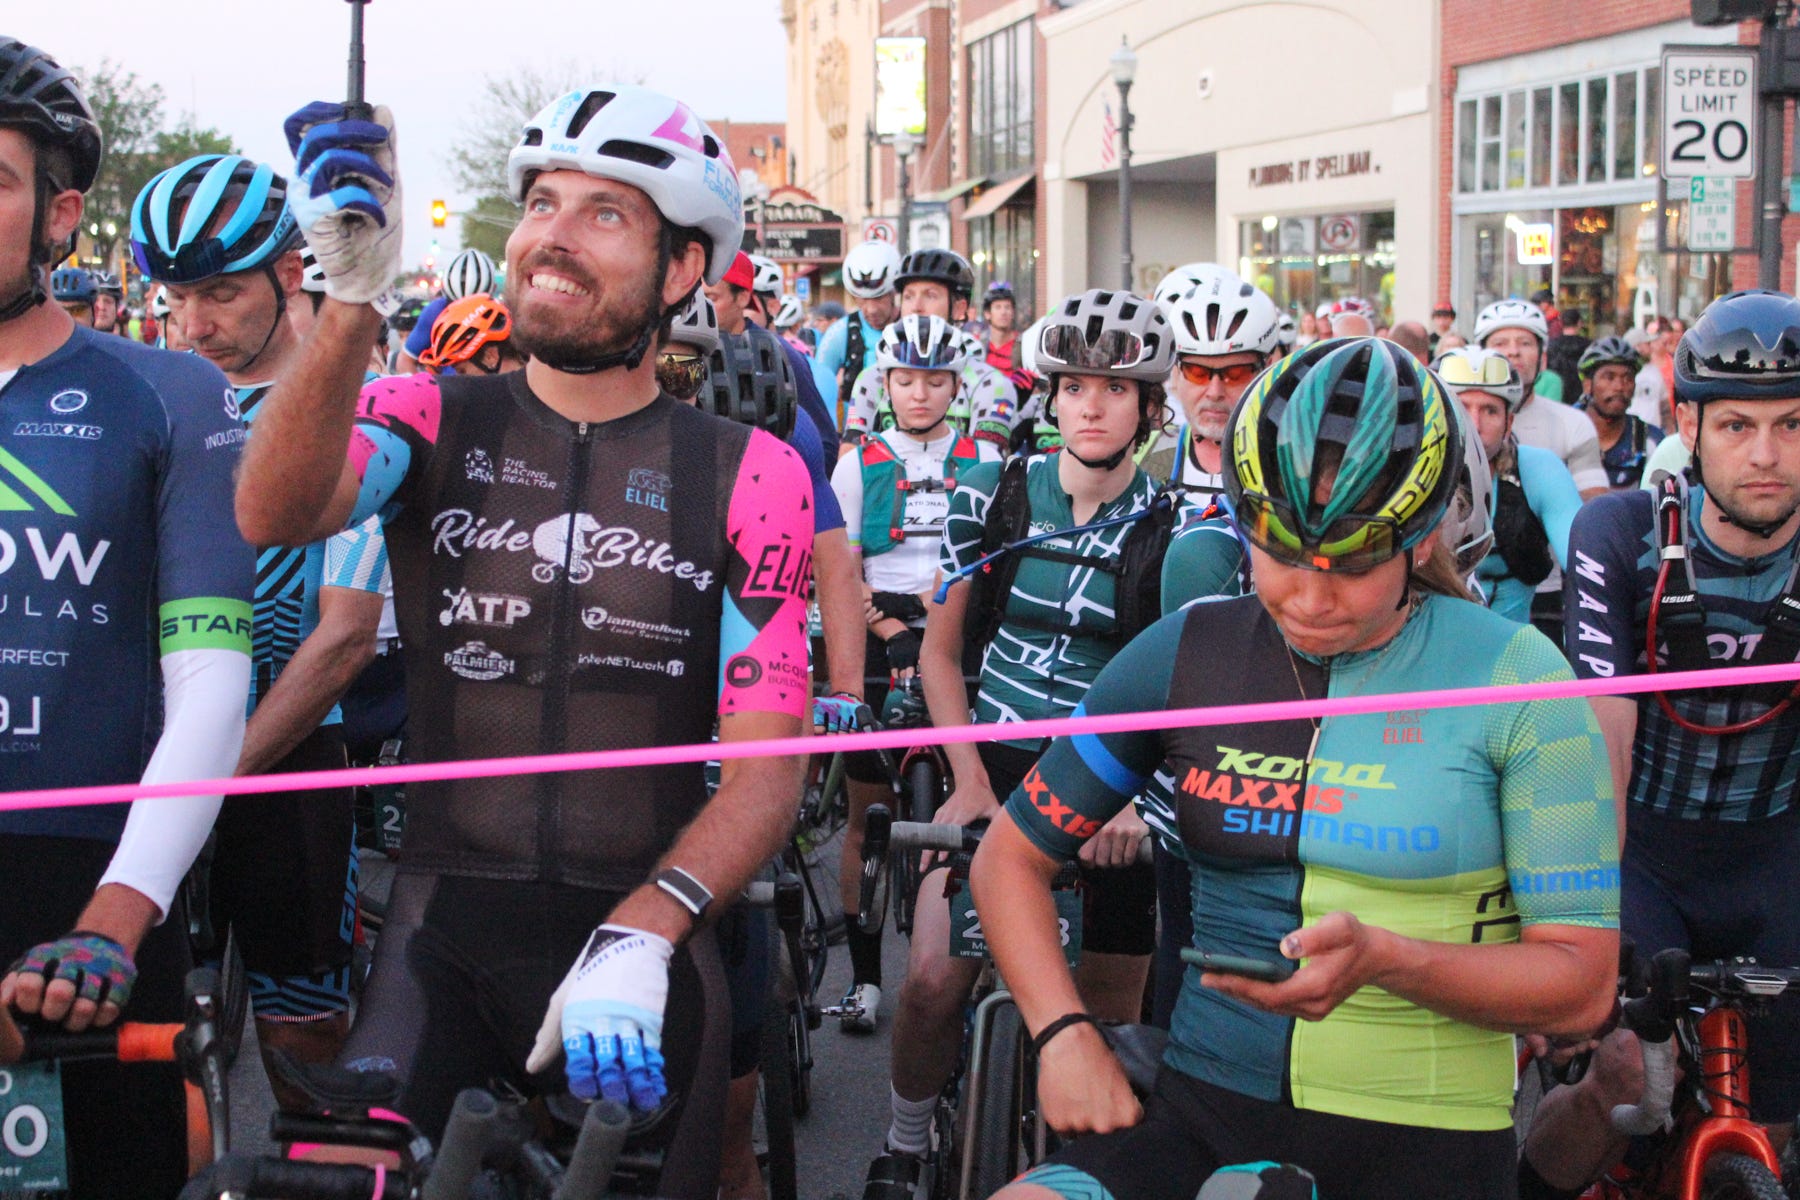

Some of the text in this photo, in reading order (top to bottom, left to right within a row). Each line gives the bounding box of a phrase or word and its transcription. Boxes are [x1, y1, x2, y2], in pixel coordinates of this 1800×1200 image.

[1673, 69, 1748, 87] SPEED
[1680, 94, 1738, 113] LIMIT
[1671, 119, 1749, 163] 20
[1315, 150, 1371, 180] SPELLMAN
[13, 422, 104, 440] MAXXIS
[504, 458, 527, 468] THE
[501, 475, 558, 490] REALTOR
[502, 467, 549, 480] RACING
[624, 487, 668, 513] ELIEL
[431, 508, 714, 591] Ride Bikes
[1661, 594, 1696, 604] USWE
[455, 595, 532, 625] ATP
[1575, 549, 1616, 678] MAAP
[0, 648, 70, 667] RFECT
[444, 653, 515, 674] PALMIERI
[1383, 727, 1425, 745] ELIEL
[1180, 766, 1346, 815] MAXXIS
[1222, 807, 1441, 853] SHIMANO
